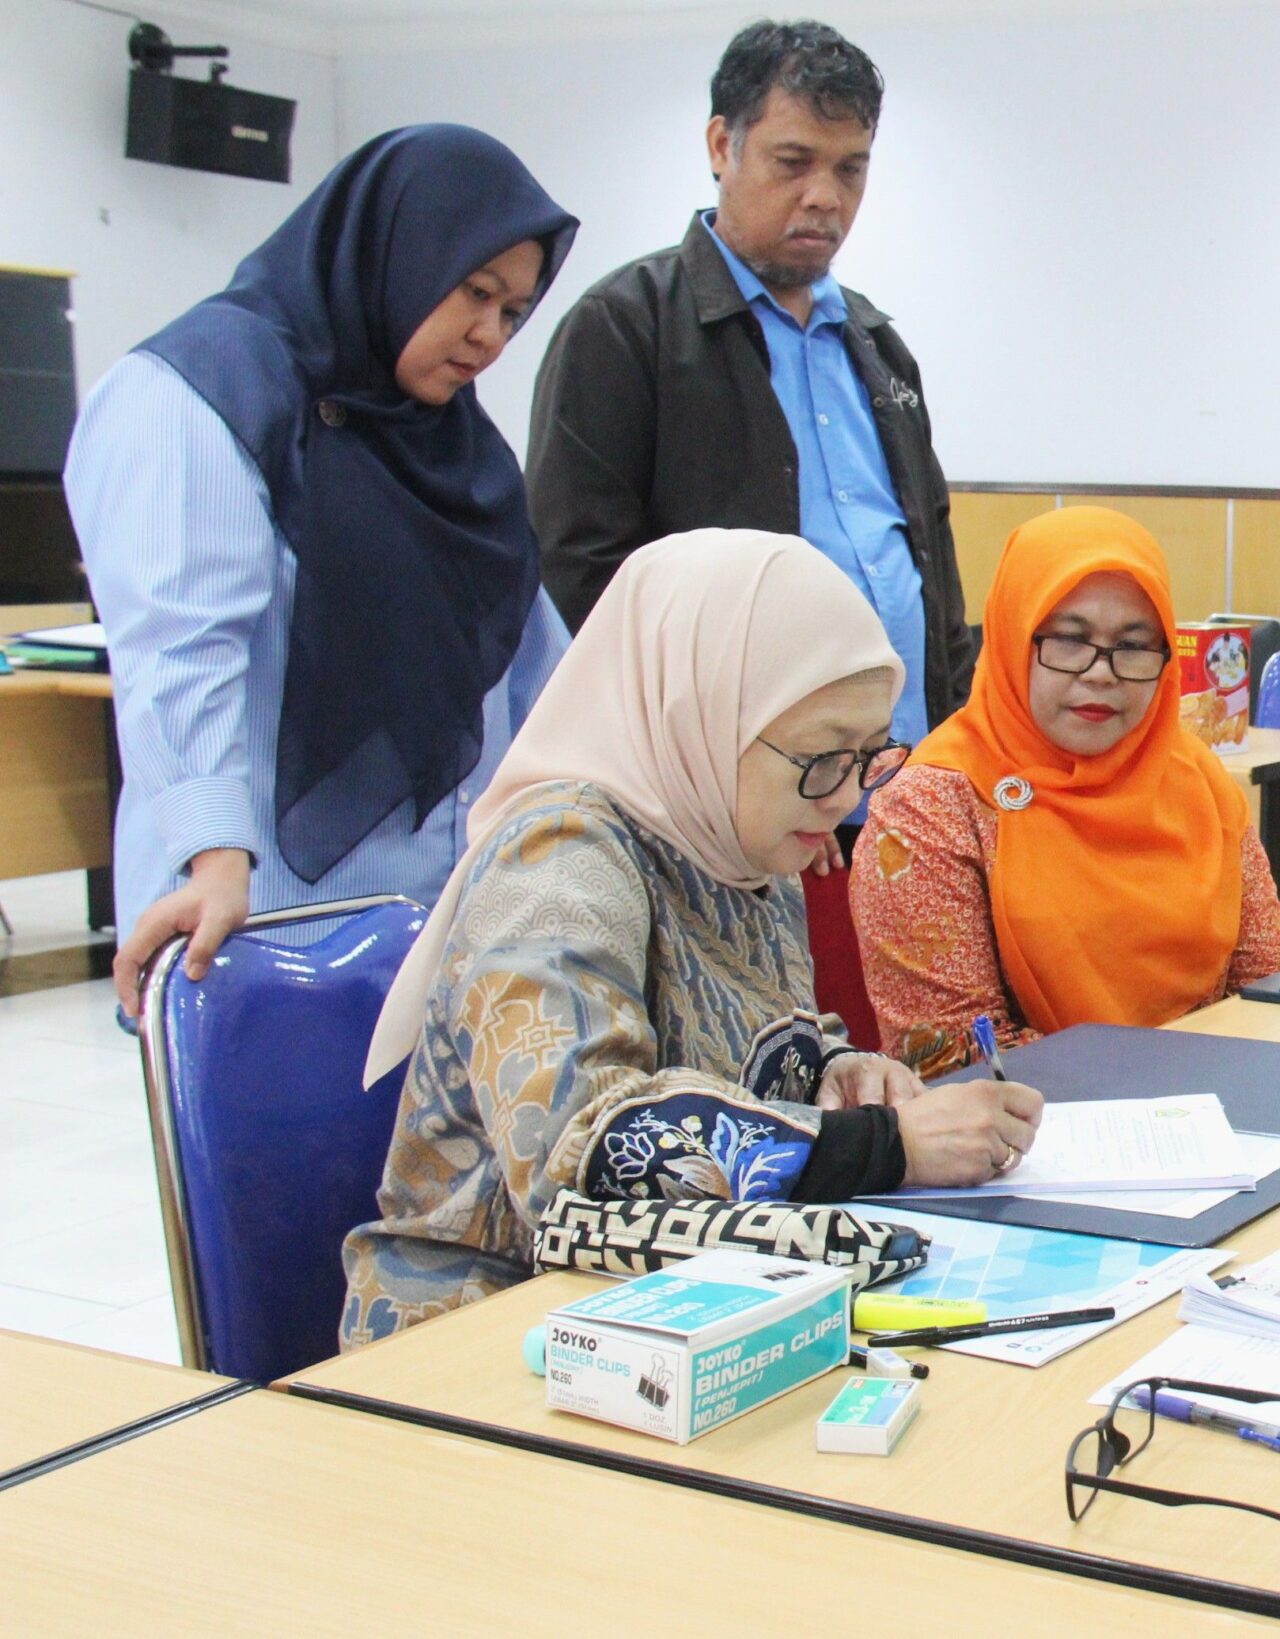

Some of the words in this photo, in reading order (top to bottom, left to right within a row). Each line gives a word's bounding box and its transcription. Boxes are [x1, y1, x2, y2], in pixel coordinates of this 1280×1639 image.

[552, 1328, 597, 1352] JOYKO
[696, 1343, 785, 1396] BINDER
[790, 1310, 843, 1352] CLIPS
[551, 1345, 594, 1368] BINDER
[597, 1358, 631, 1377] CLIPS
[697, 1344, 742, 1374] JOYKO
[695, 1370, 764, 1411] (PENJEPIT)
[693, 1397, 737, 1431] NO.260
